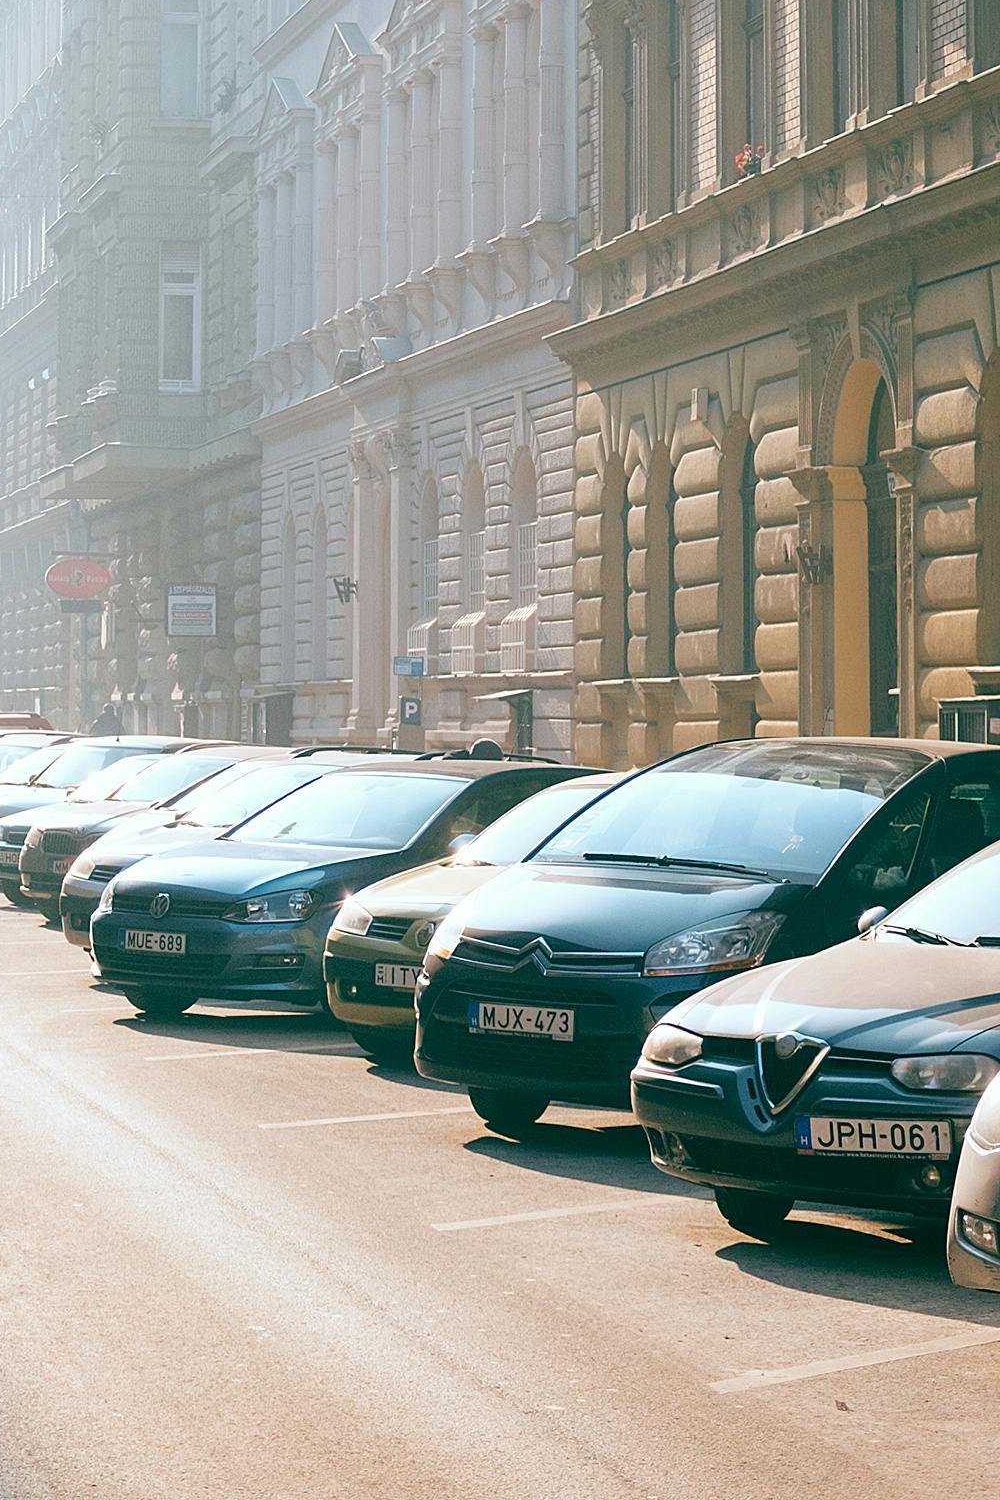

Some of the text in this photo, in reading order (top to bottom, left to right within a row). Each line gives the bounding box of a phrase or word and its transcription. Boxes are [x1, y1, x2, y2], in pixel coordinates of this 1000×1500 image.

[405, 702, 418, 719] P
[127, 932, 183, 951] MUE-689
[483, 1006, 569, 1033] MJX-473
[800, 1121, 940, 1151] H JPH-061
